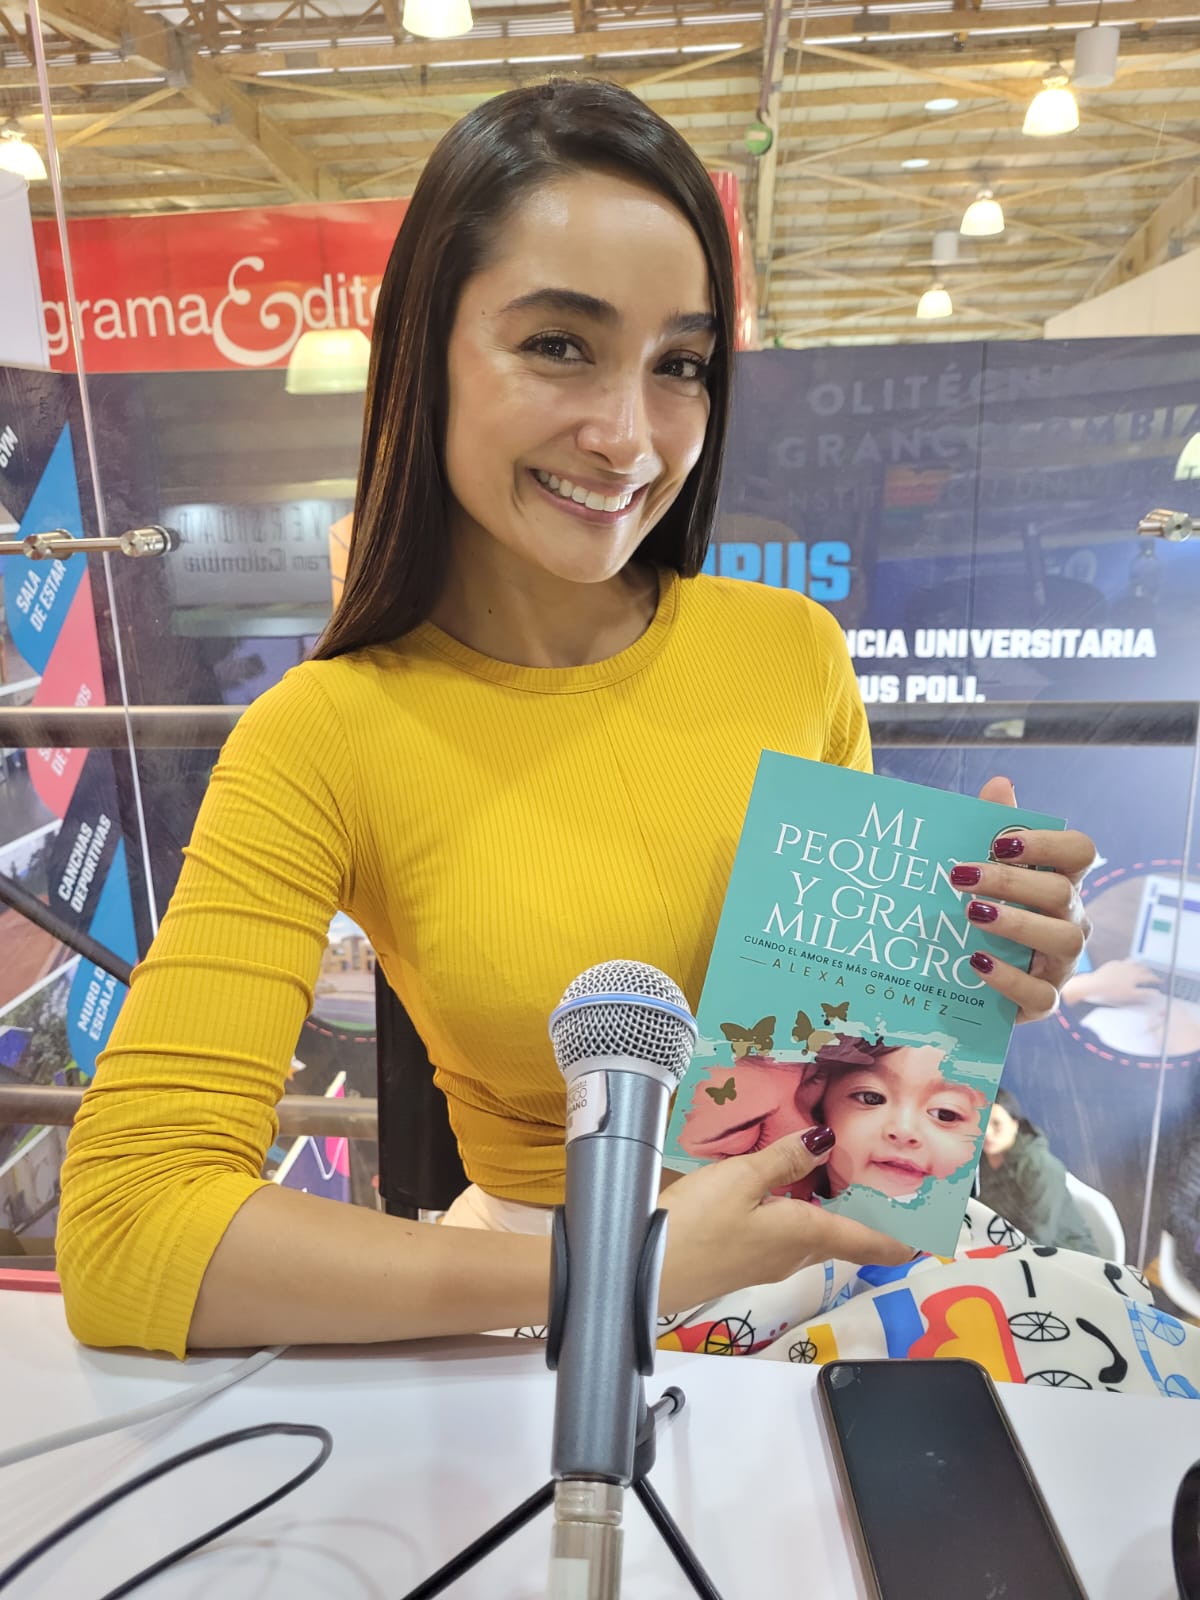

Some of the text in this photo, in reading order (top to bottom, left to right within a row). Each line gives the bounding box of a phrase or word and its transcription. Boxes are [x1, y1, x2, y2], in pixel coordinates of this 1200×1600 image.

[16, 569, 41, 614] SALA
[30, 559, 67, 633] DE ESTAR
[701, 541, 851, 601] PUS
[914, 628, 1157, 658] UNIVERSITARIA
[857, 674, 986, 703] US POLI.
[857, 801, 926, 851] MI
[57, 821, 92, 902] CANCHAS
[70, 813, 112, 913] DEPORTIVAS
[773, 822, 977, 902] PEQUEÑ
[790, 870, 974, 949] Y GRAN
[744, 935, 985, 1008] CUANDO EL AMOR ES MÁS GRANDE QUE EL DOLOR
[762, 902, 986, 989] MILAGRO
[77, 980, 101, 1032] MURO
[89, 974, 118, 1041] ESCALA
[772, 958, 948, 1016] ALEXA GÓMEZ
